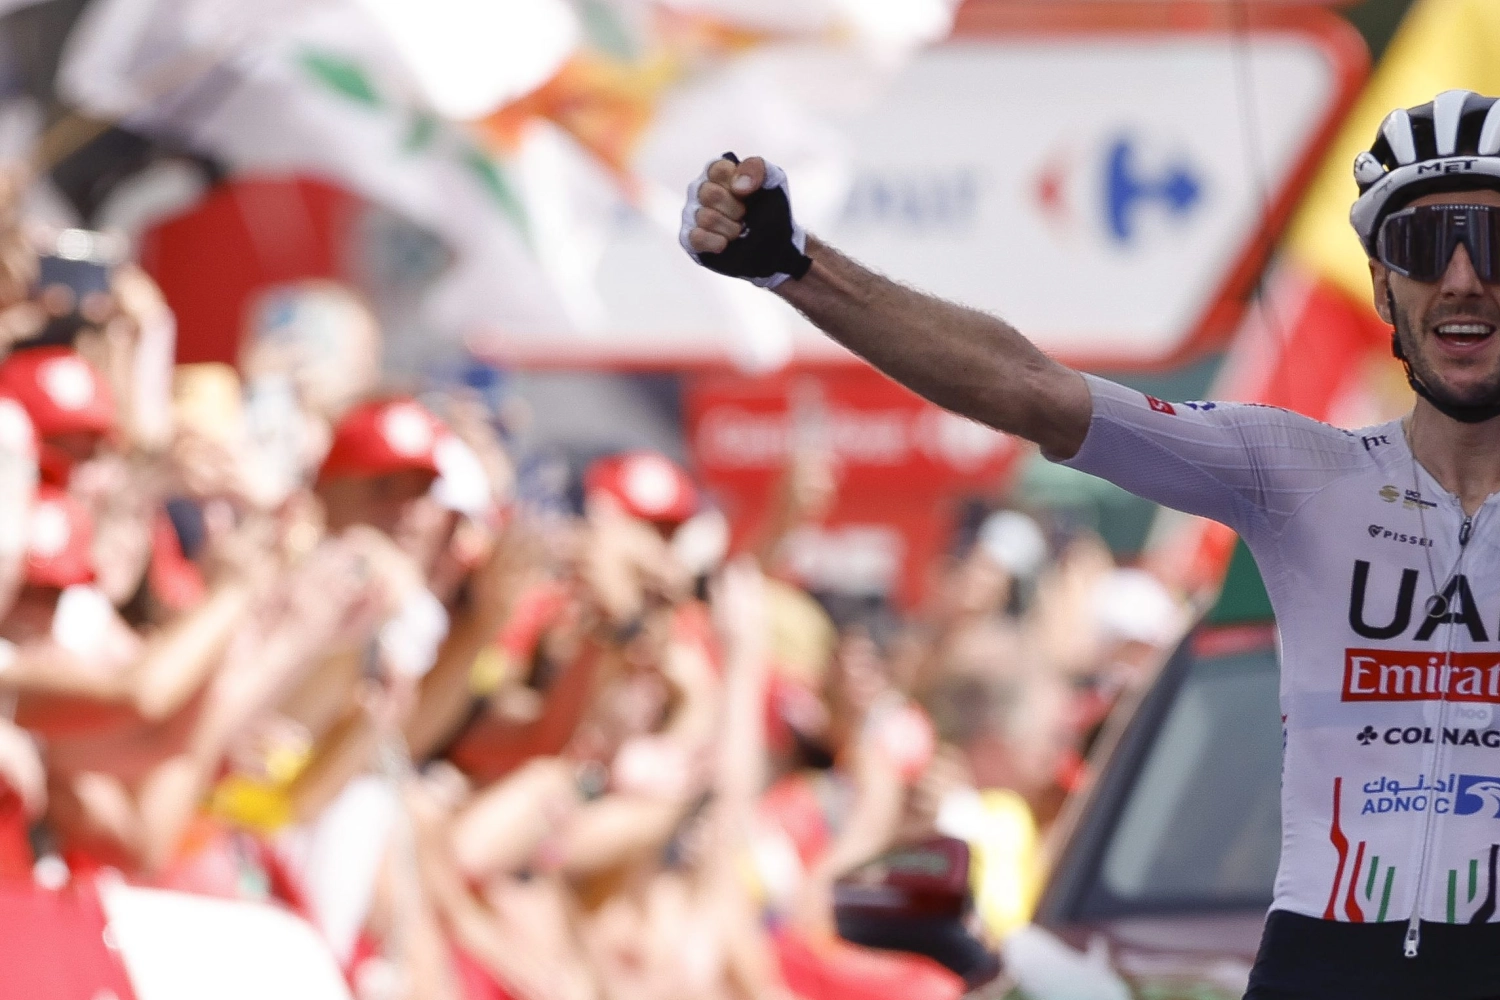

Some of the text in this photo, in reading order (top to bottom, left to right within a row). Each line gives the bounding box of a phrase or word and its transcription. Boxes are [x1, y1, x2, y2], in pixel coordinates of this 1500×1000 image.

[1417, 159, 1478, 175] MET
[1383, 529, 1434, 548] PISSEI
[1361, 795, 1450, 816] ADNOC
